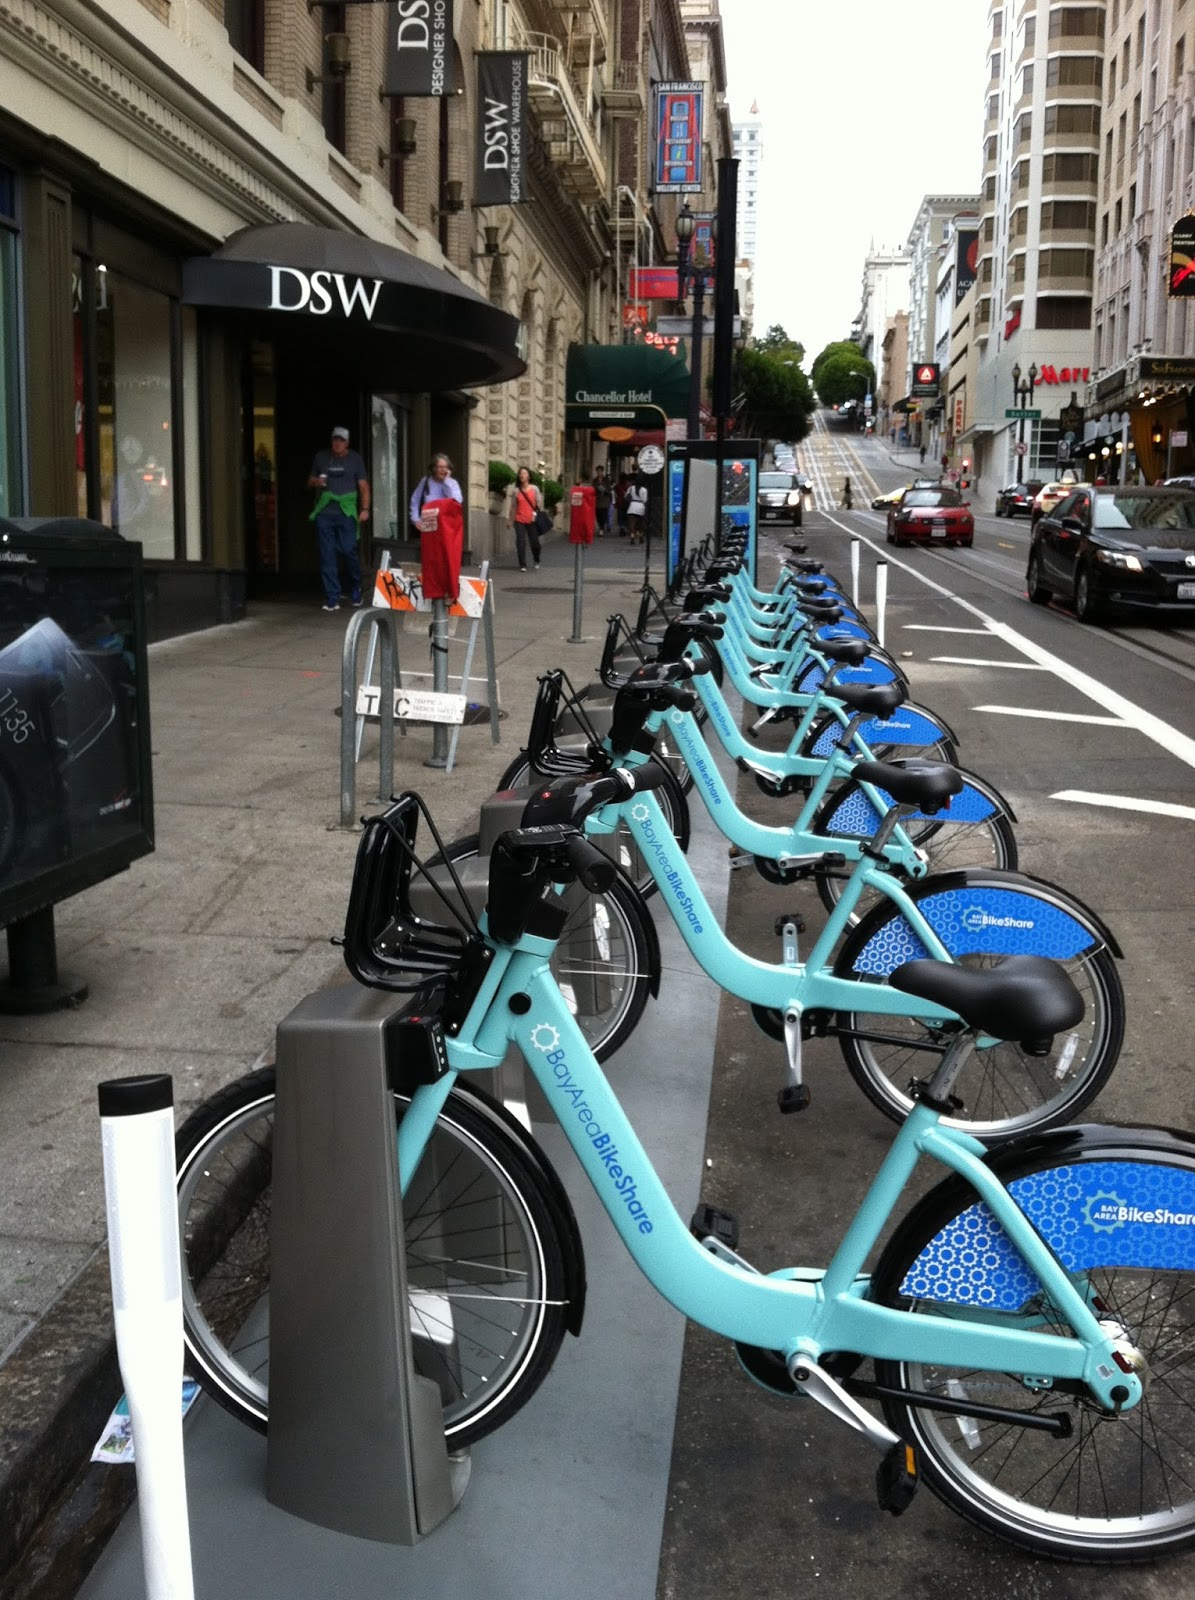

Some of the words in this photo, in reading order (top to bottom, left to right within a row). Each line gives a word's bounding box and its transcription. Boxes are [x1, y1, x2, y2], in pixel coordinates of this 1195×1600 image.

[431, 33, 445, 95] DESIGNER
[511, 60, 522, 124] WAREHOUSE
[658, 82, 670, 91] SAN
[671, 82, 703, 91] FRANCISCO
[484, 97, 508, 171] DSW
[510, 127, 521, 154] SHOE
[267, 265, 384, 321] DSW
[575, 390, 627, 403] Chancellor
[628, 390, 652, 403] Hotel
[955, 400, 963, 428] PARK
[640, 819, 704, 934] BayAreaBikeShare
[982, 915, 1034, 929] BikeShare
[546, 1049, 653, 1235] BayAreaBikeShare
[1093, 1212, 1118, 1221] AREA
[1101, 1205, 1119, 1213] BAY
